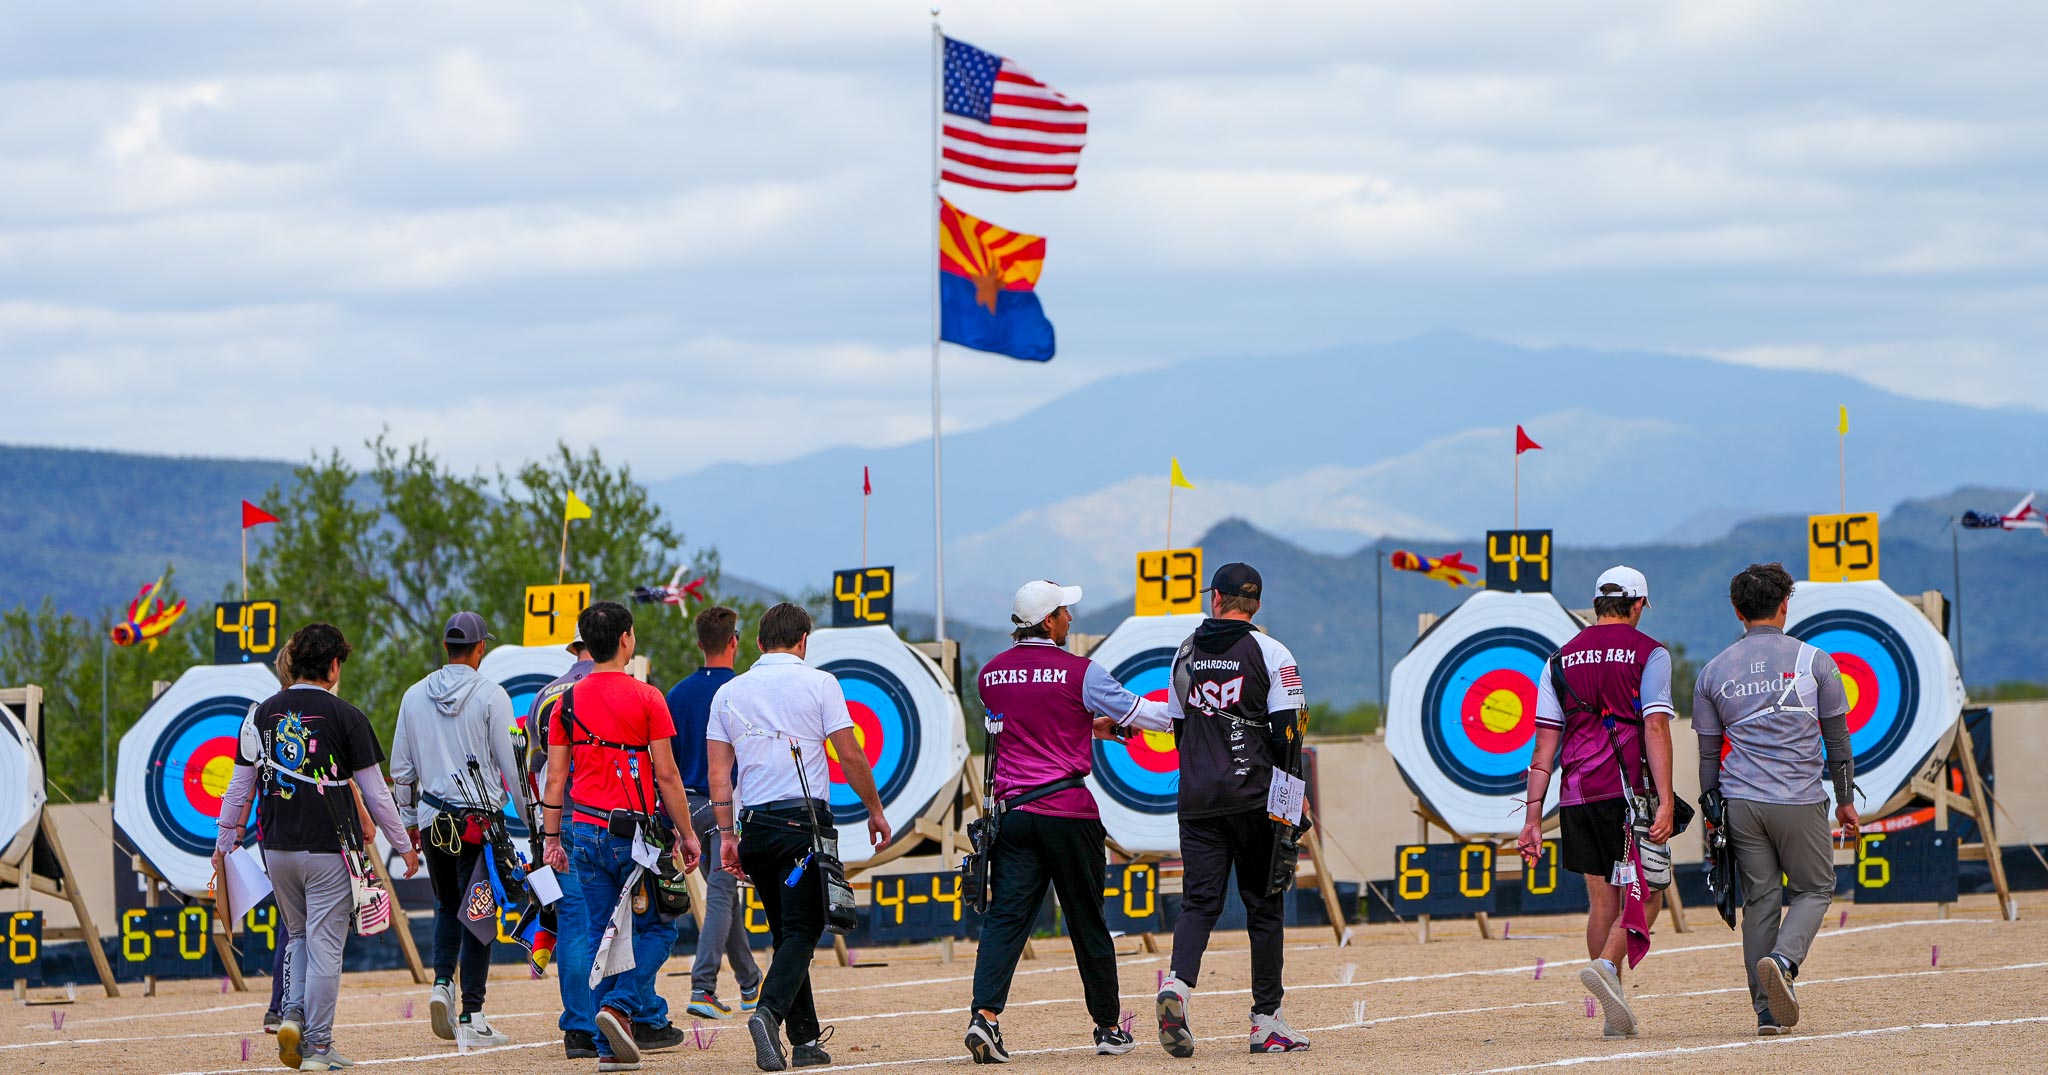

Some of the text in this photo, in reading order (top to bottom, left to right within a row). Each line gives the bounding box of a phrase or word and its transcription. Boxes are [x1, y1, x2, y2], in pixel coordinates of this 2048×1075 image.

[1488, 534, 1550, 582] 44
[1812, 516, 1873, 571] 45
[835, 568, 891, 622] 42
[1140, 552, 1196, 604] 43
[216, 602, 276, 654] 40
[528, 590, 585, 636] 41
[983, 668, 1068, 688] TEXAS A&M
[1193, 659, 1240, 671] ICHARDSON
[1562, 648, 1636, 669] TEXAS A&M
[1750, 661, 1766, 675] LEE
[1187, 675, 1245, 717] USA
[1720, 672, 1797, 699] Canada
[1278, 786, 1289, 806] 51C
[1398, 844, 1491, 900] 6 0
[1858, 833, 1890, 888] 6
[468, 887, 494, 916] VEGA
[875, 875, 962, 925] 4-4
[122, 905, 208, 962] 6-0
